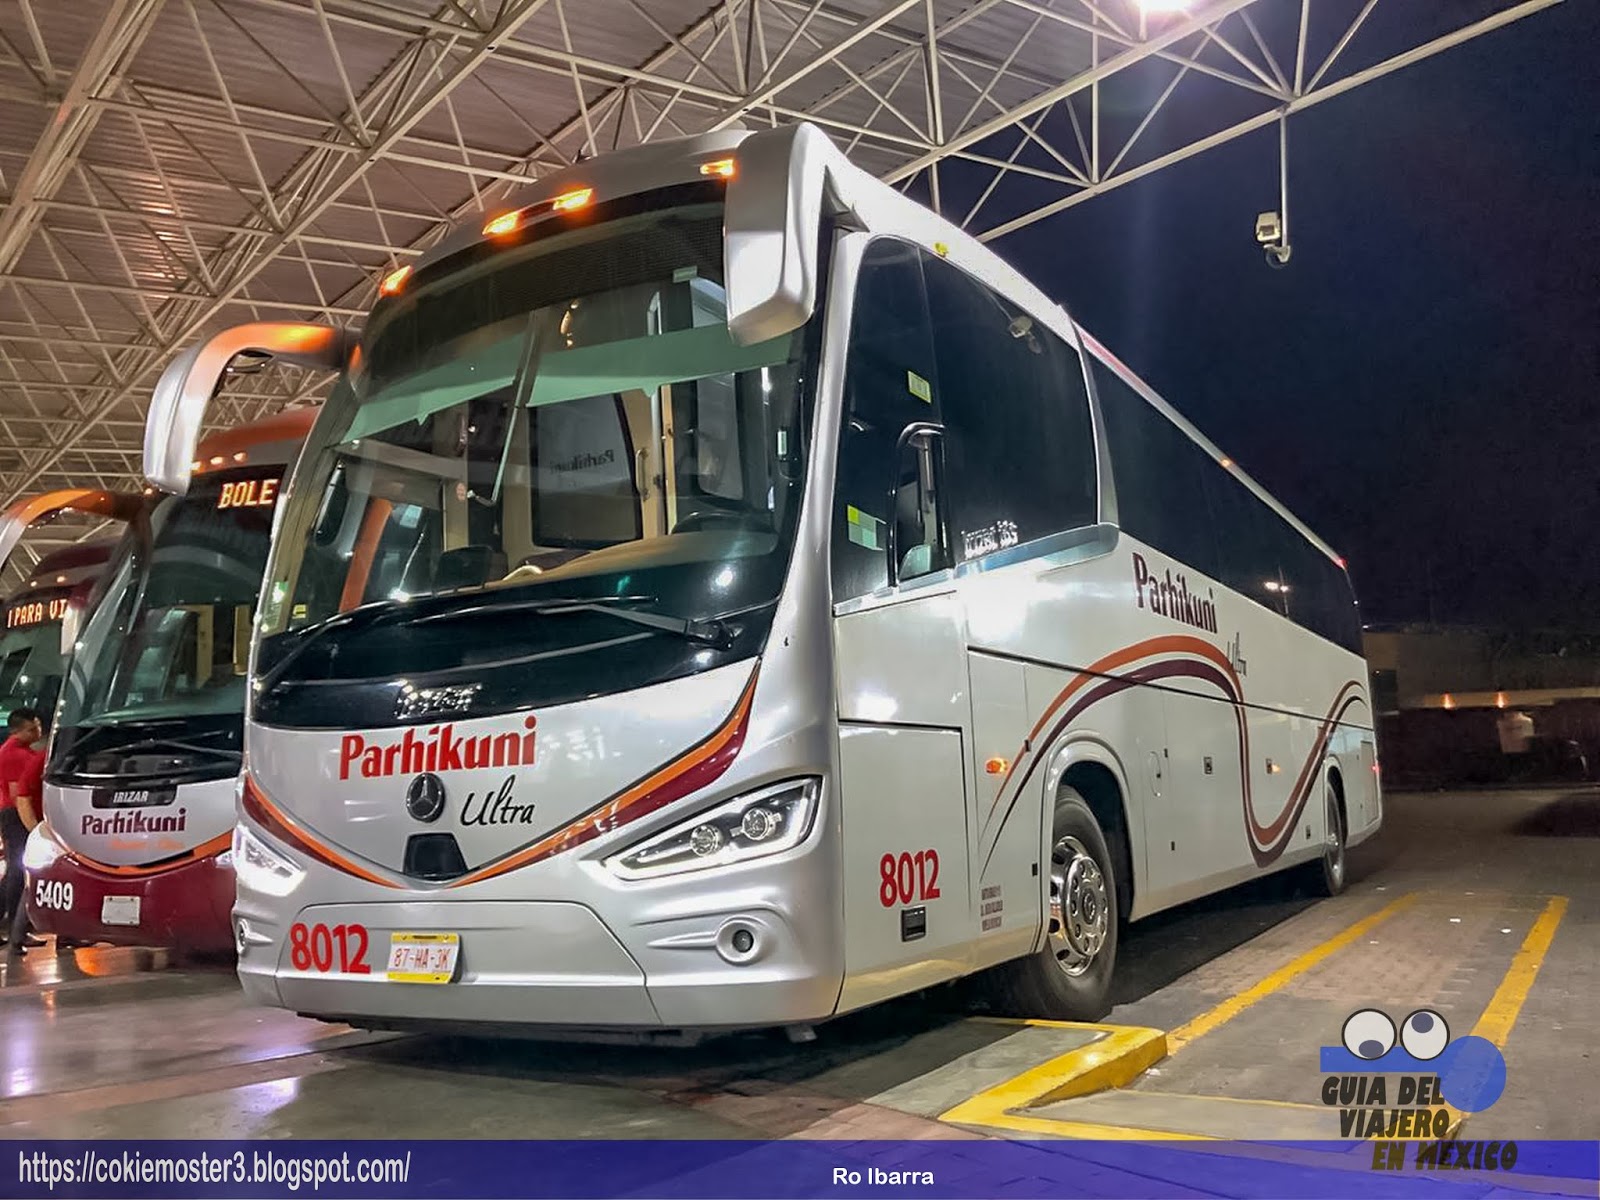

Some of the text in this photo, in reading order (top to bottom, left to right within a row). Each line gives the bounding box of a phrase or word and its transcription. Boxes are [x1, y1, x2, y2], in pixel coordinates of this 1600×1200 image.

[217, 478, 279, 509] BOLE
[13, 602, 43, 626] PARA
[1132, 552, 1218, 634] Parhikuni
[339, 715, 537, 780] Parhikuni
[113, 790, 149, 804] IRIZAR
[459, 774, 535, 827] Ultra
[81, 807, 187, 836] Parhikuni
[35, 880, 74, 911] 5409
[879, 849, 941, 908] 8012
[290, 922, 371, 975] 8012
